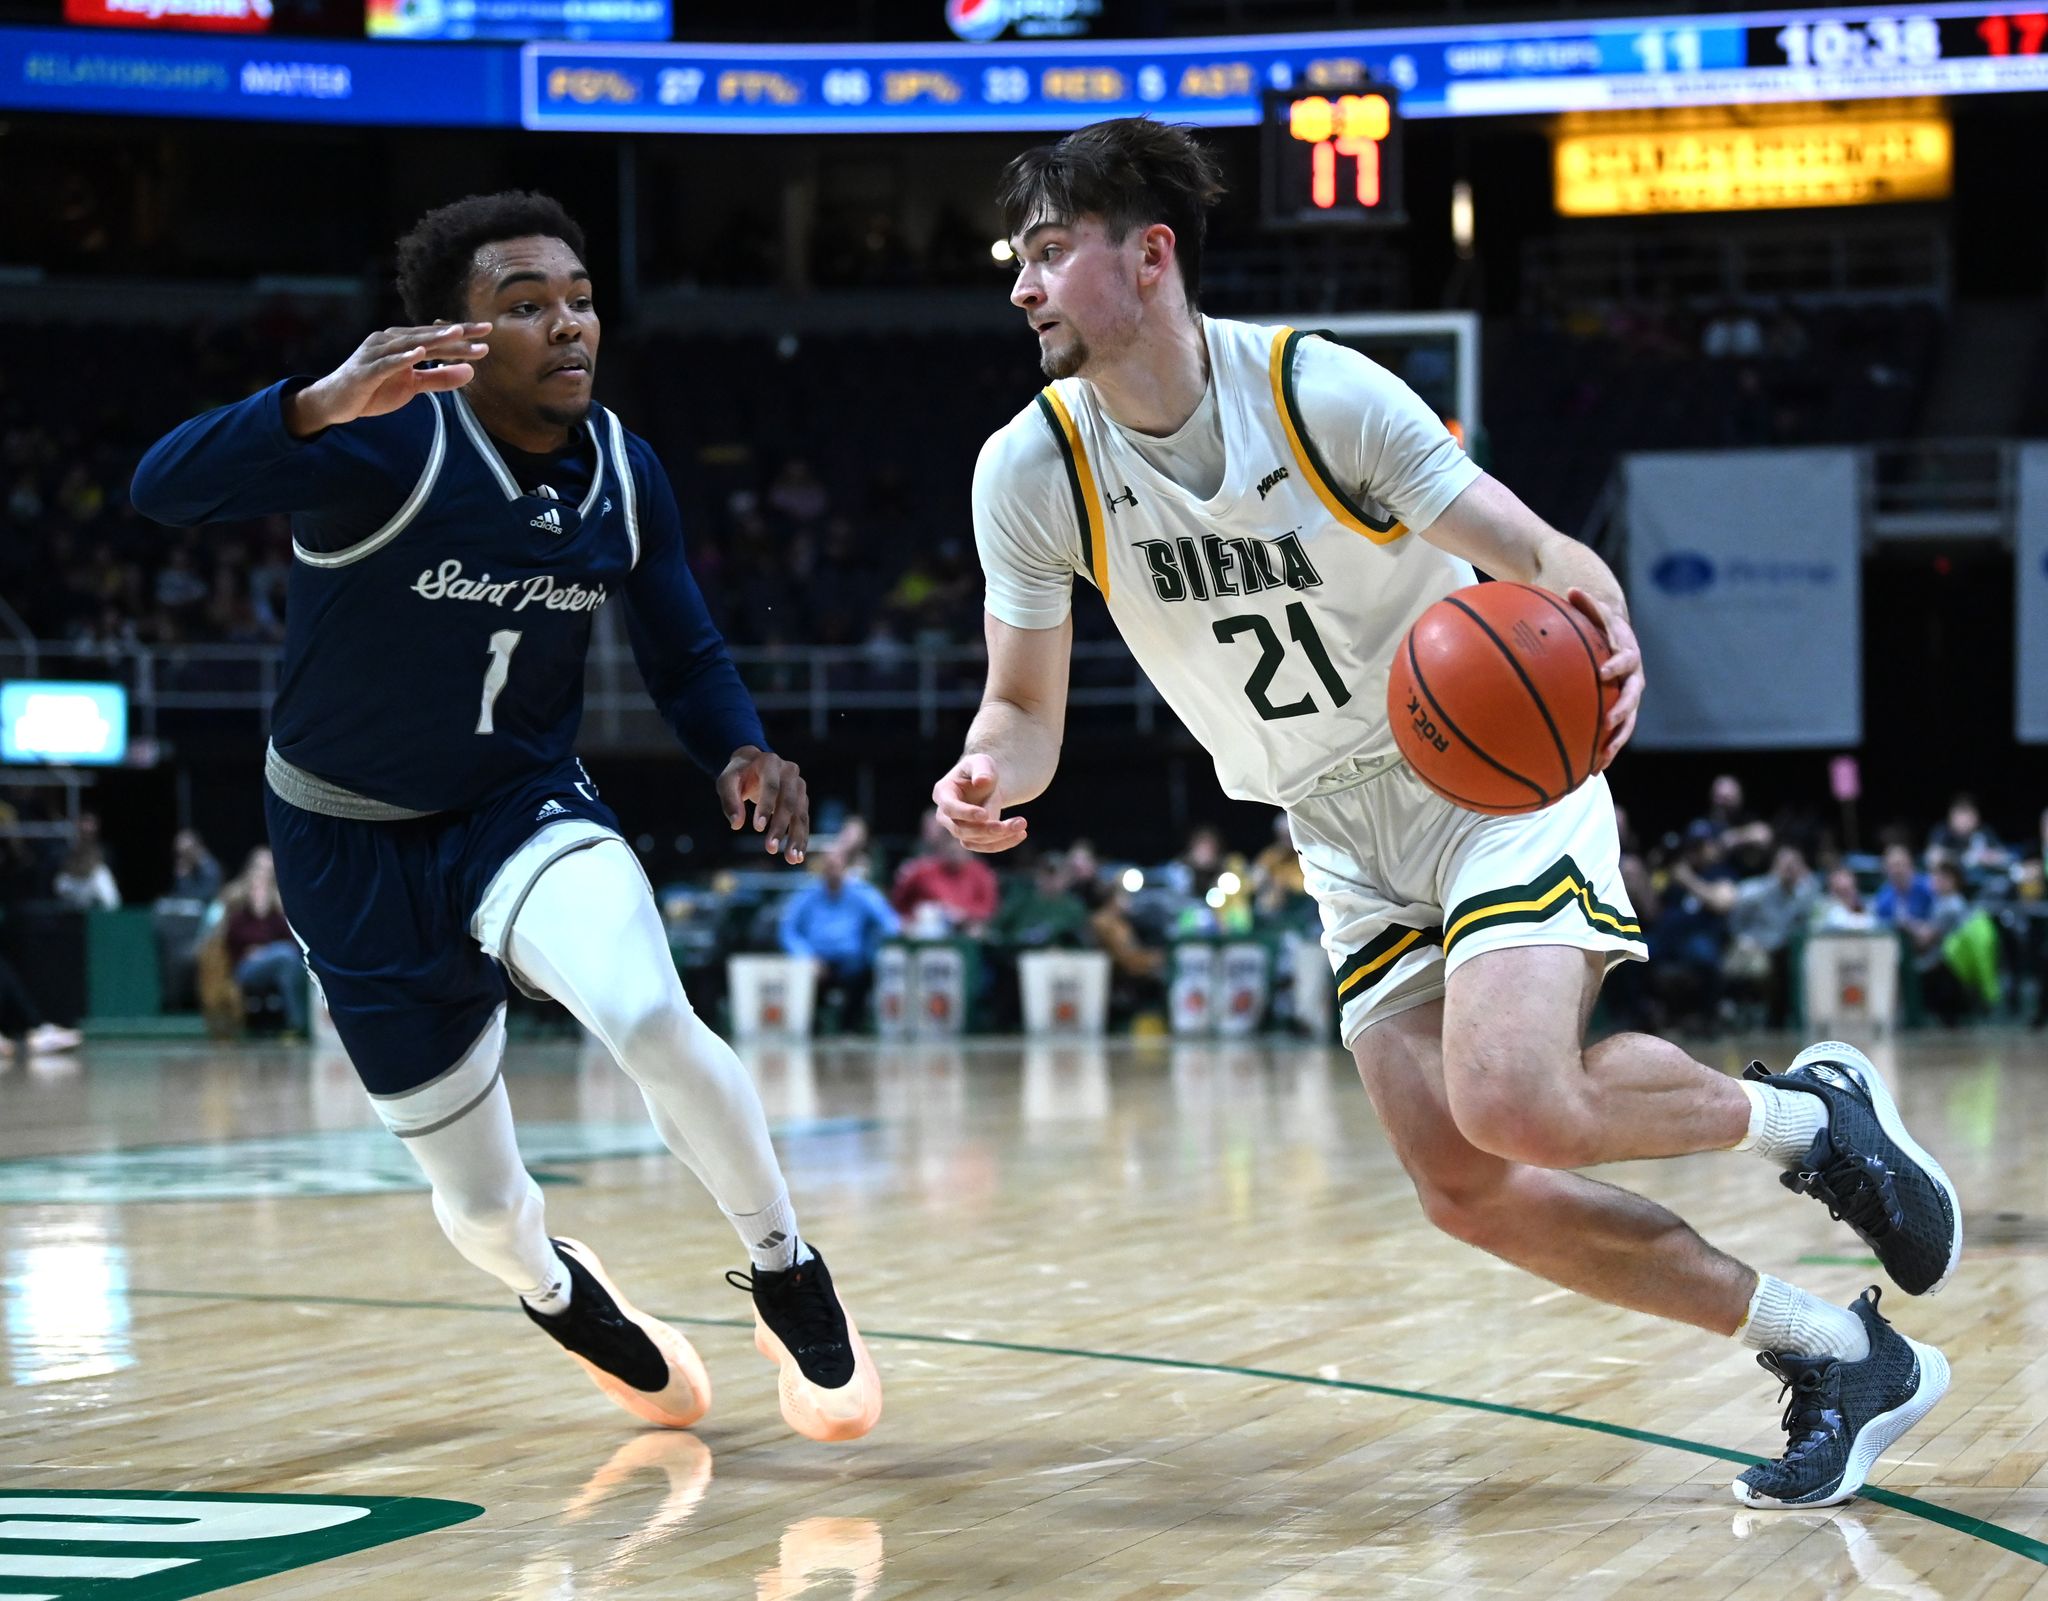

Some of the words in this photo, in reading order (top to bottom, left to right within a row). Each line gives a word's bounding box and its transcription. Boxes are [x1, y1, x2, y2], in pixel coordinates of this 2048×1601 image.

[1632, 28, 1700, 75] 11
[1777, 17, 1941, 68] 10:38
[1977, 13, 2048, 57] 17
[240, 61, 351, 98] MATTER
[1312, 138, 1379, 208] 17
[1256, 466, 1289, 501] MAAC
[529, 517, 563, 535] adidas
[410, 559, 520, 607] Saint
[1131, 530, 1324, 602] SIENA
[474, 628, 523, 735] 1
[1211, 601, 1352, 721] 21
[1406, 695, 1450, 753] ROCK
